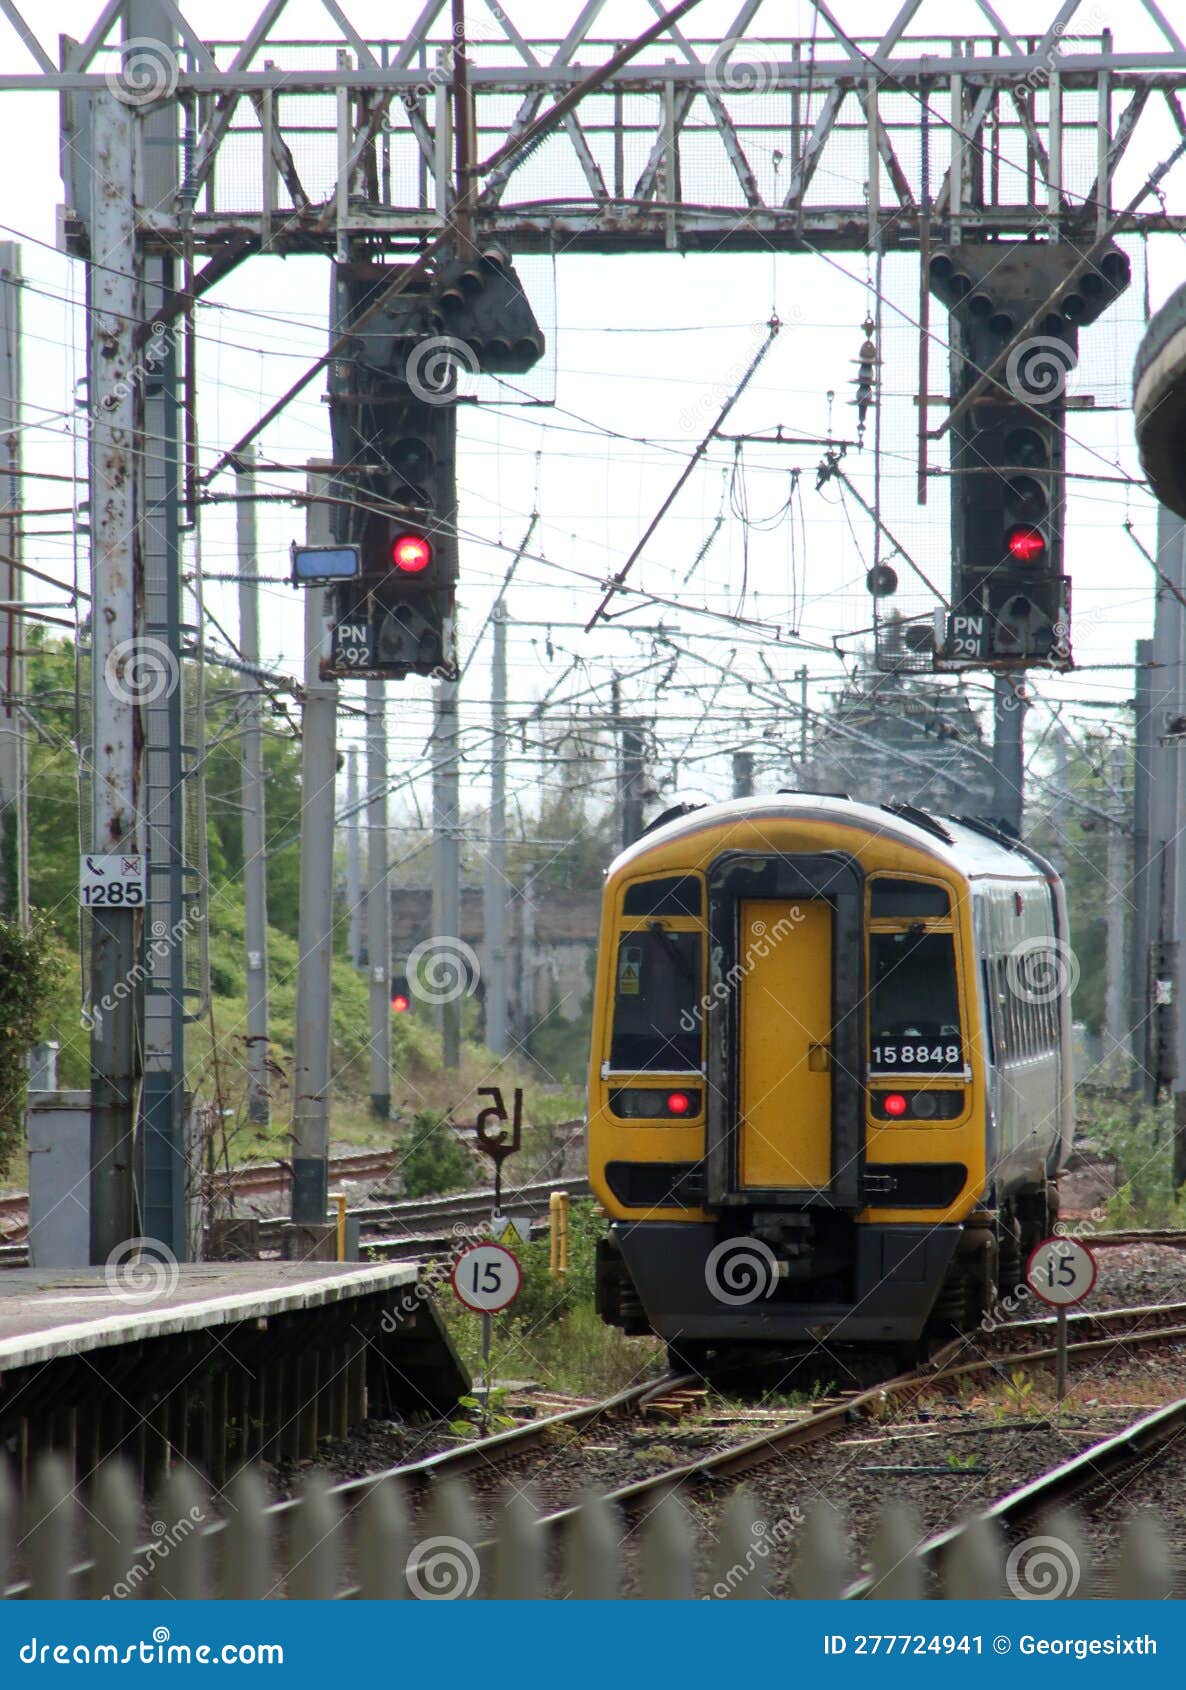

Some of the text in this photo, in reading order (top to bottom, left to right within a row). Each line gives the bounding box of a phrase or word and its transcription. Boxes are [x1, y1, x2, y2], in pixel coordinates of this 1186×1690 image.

[338, 625, 367, 643] PN
[953, 616, 983, 635] PN
[335, 647, 370, 668] 292
[953, 638, 981, 657] 291
[83, 882, 143, 904] 1285
[872, 1045, 959, 1063] 158848
[472, 1262, 502, 1294] 15
[1048, 1256, 1076, 1287] 15
